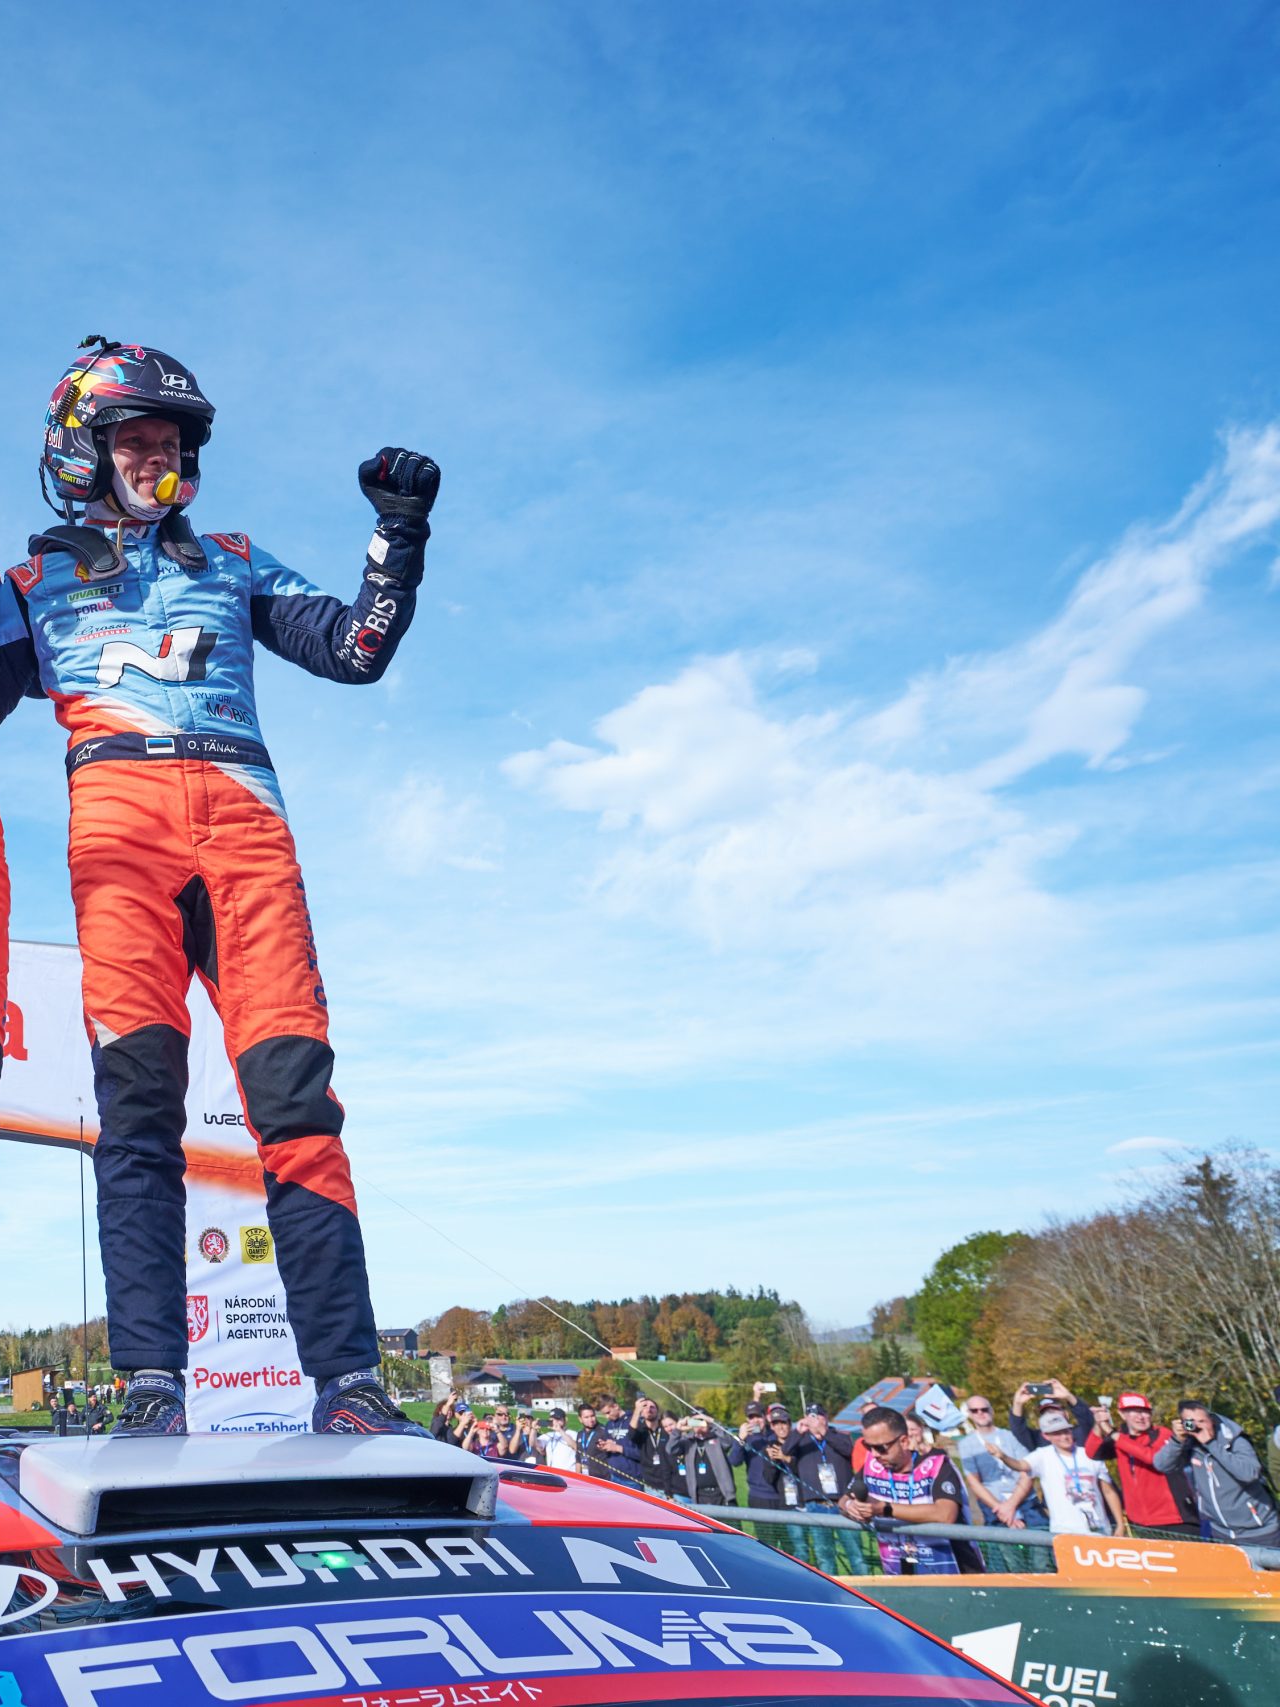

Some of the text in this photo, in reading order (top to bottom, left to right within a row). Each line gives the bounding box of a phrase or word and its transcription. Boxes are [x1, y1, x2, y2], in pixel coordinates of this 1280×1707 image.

[76, 401, 97, 415] Stilo
[68, 584, 123, 602] VIVATBET
[351, 592, 398, 674] MOBIS
[206, 701, 253, 726] MOBIS
[187, 739, 239, 754] O. TÄNAK
[224, 1294, 277, 1309] NÁRODNÍ
[227, 1328, 288, 1340] AGENTURA
[193, 1365, 302, 1389] Powertica
[86, 1536, 533, 1603] HYUNDAI
[1073, 1545, 1178, 1573] WRC
[44, 1610, 844, 1707] FORUM8
[1020, 1661, 1118, 1699] FUEL
